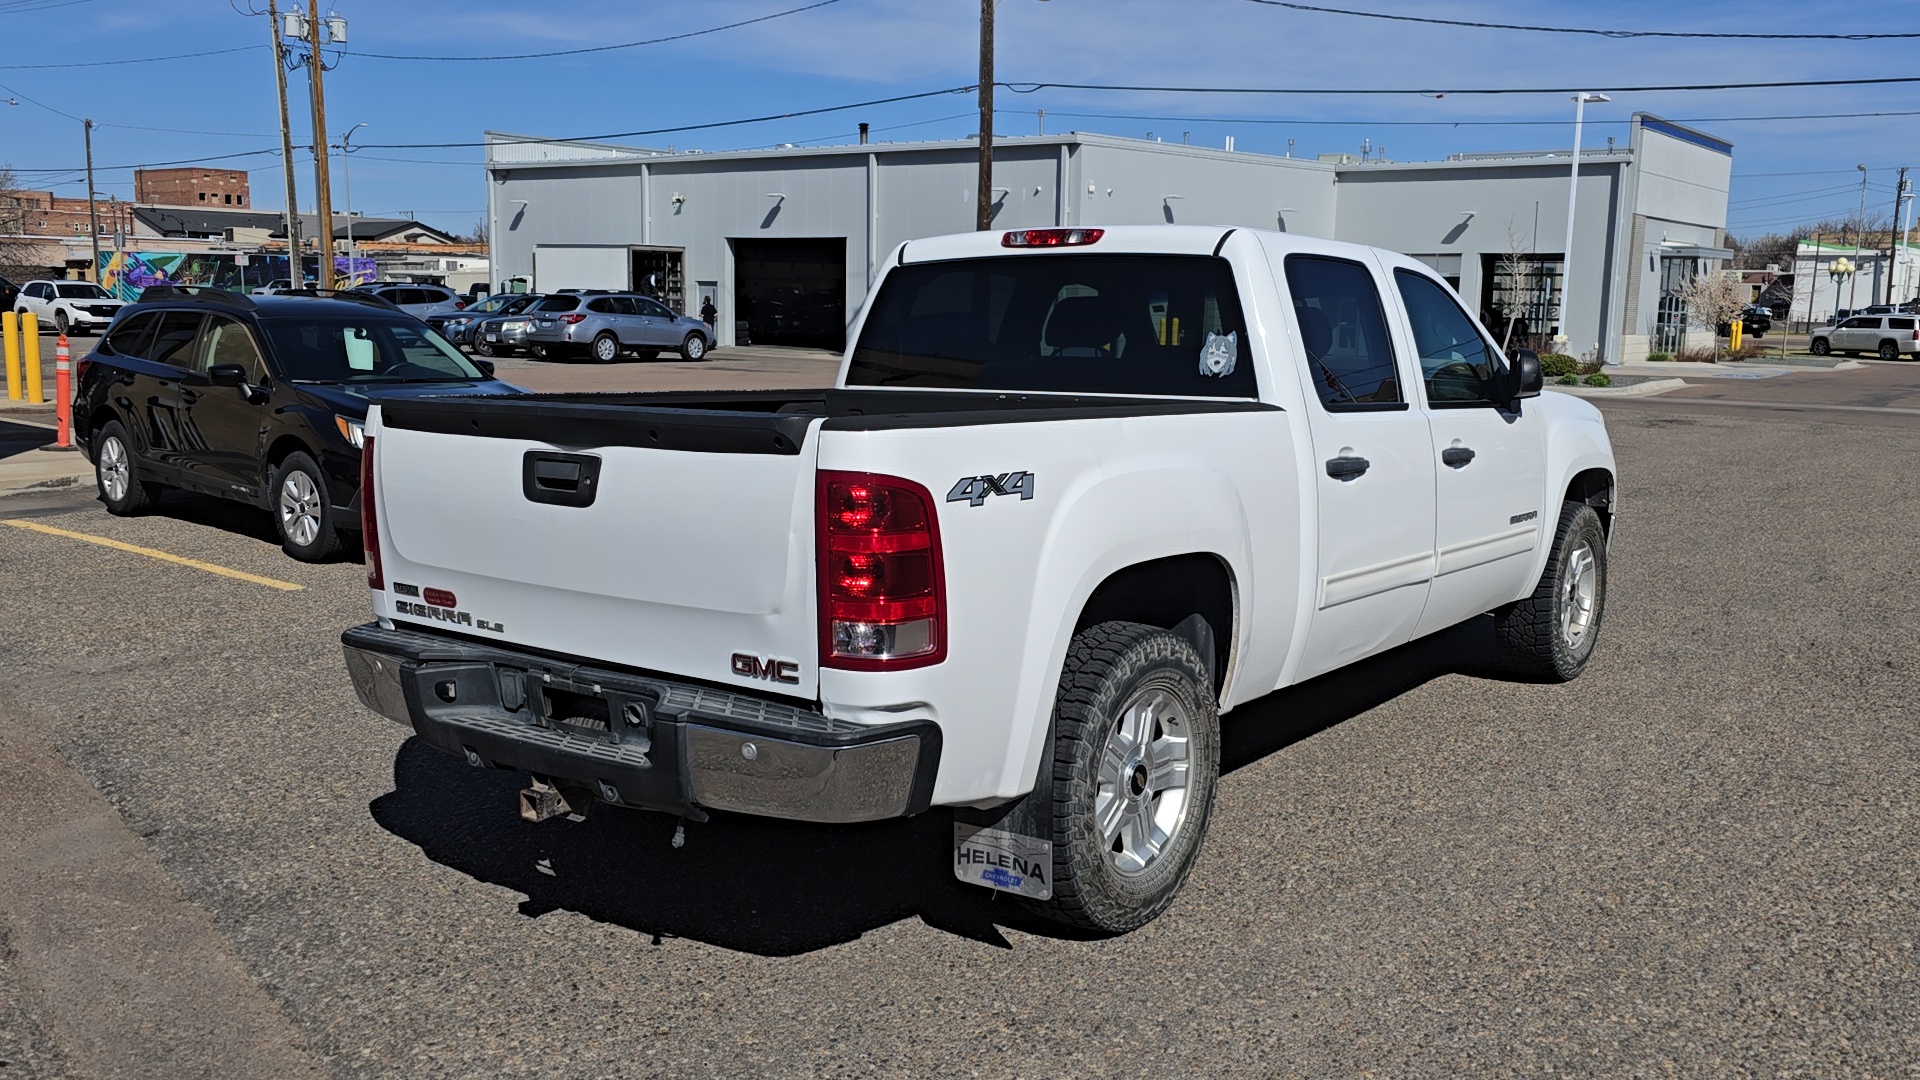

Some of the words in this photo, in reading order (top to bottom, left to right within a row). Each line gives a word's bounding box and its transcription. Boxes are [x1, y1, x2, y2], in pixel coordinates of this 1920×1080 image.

[395, 600, 473, 626] SIERRA
[477, 619, 505, 633] SLE
[731, 652, 800, 685] GMC
[957, 846, 1046, 885] HELENA
[984, 871, 1019, 885] CHEVROLET
